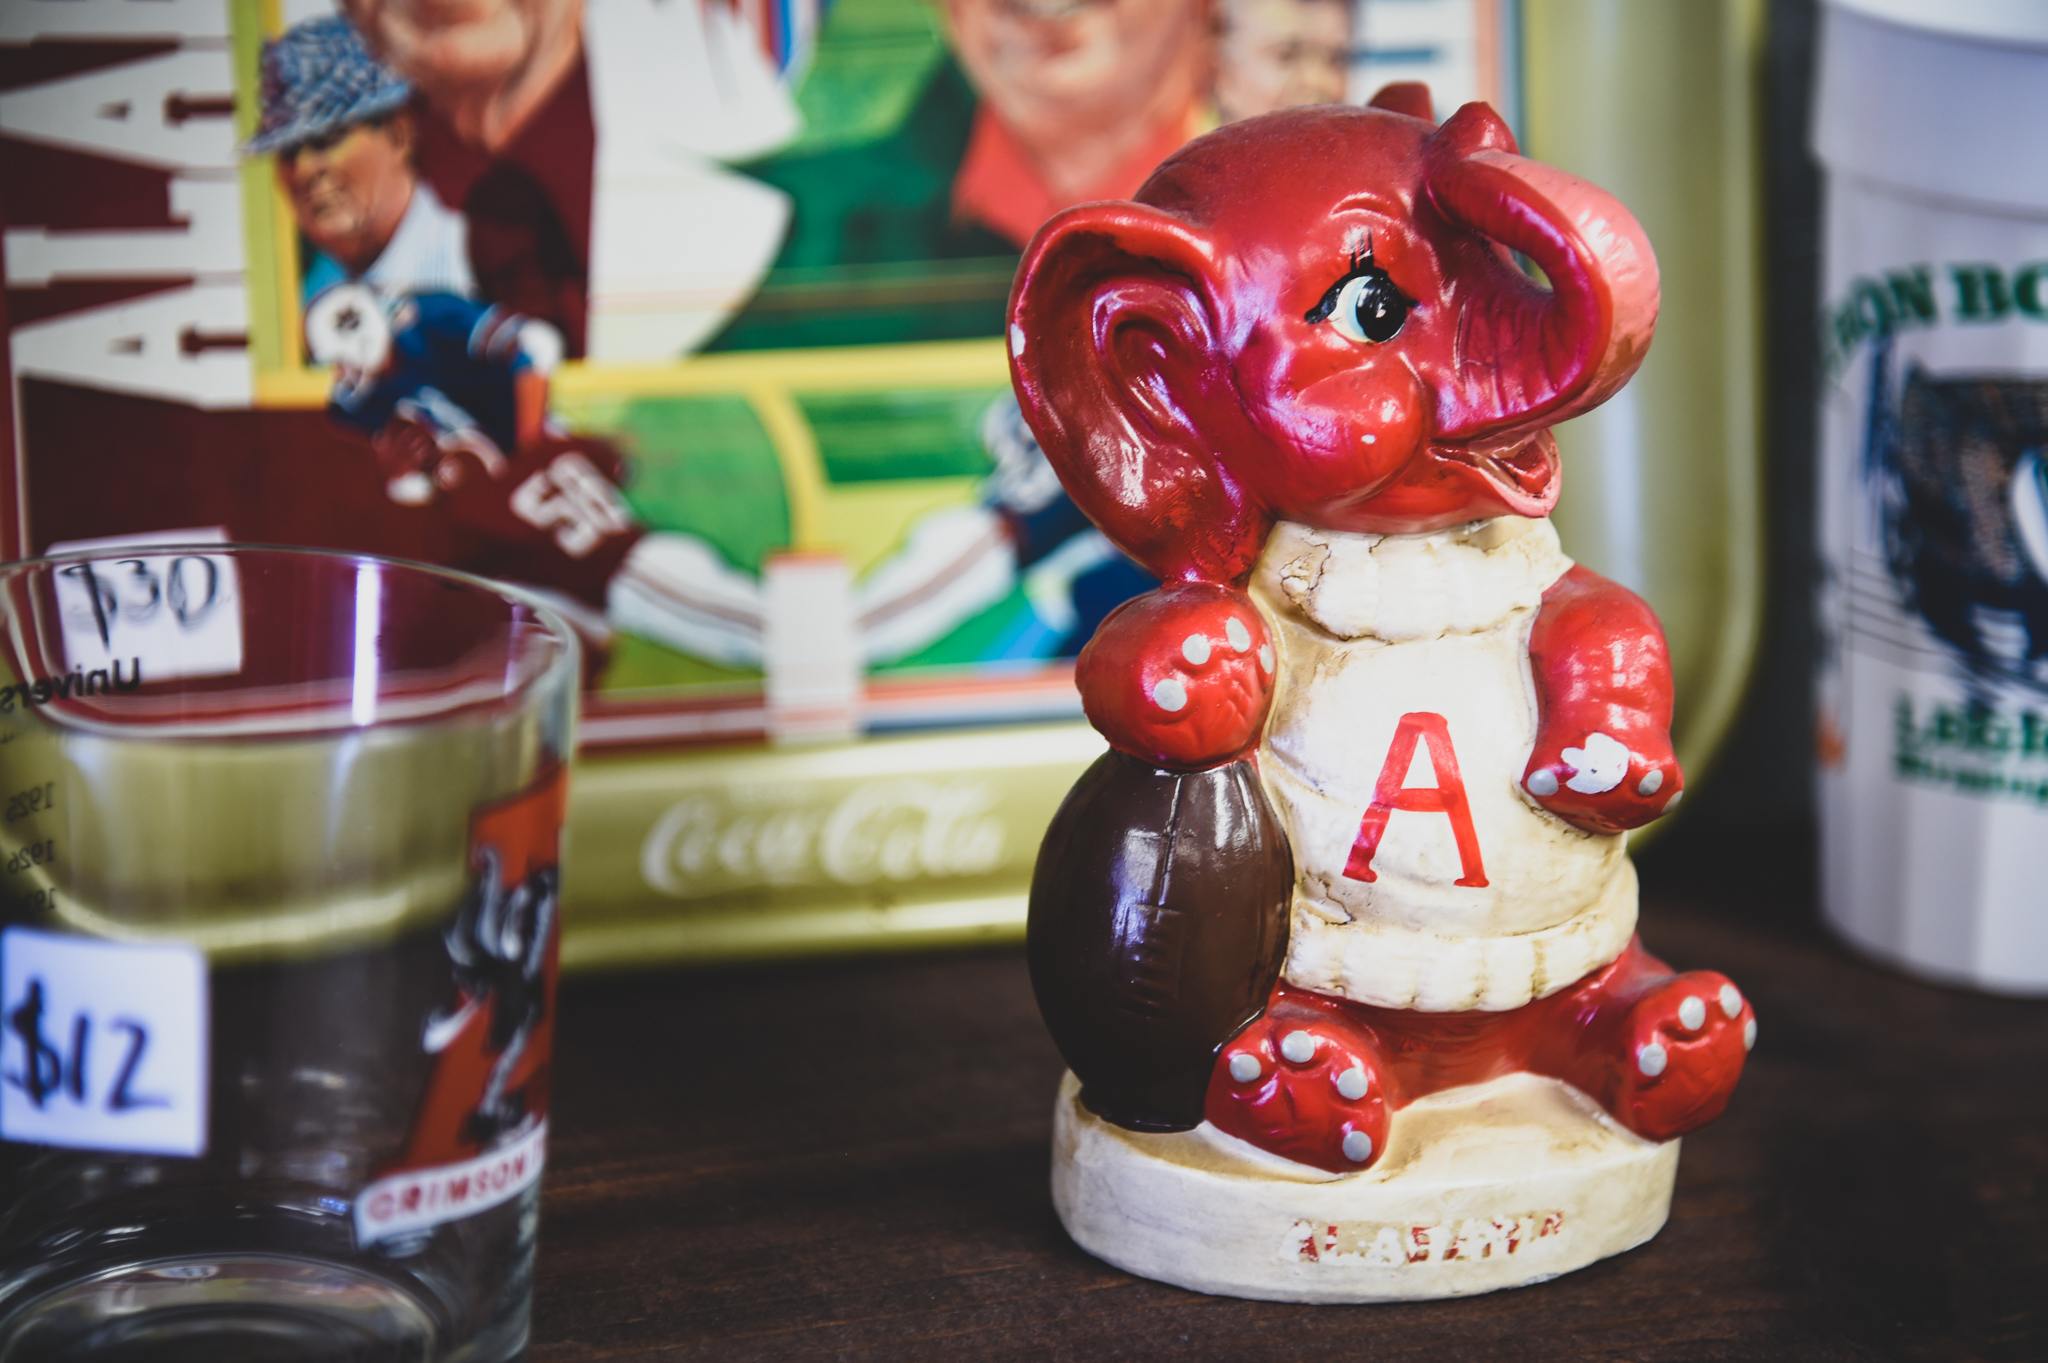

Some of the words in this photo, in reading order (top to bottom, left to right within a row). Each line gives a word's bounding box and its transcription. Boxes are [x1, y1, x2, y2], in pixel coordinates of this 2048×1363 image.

[1342, 711, 1490, 888] A
[0, 977, 172, 1110] $12
[366, 1150, 527, 1223] CRIMSON
